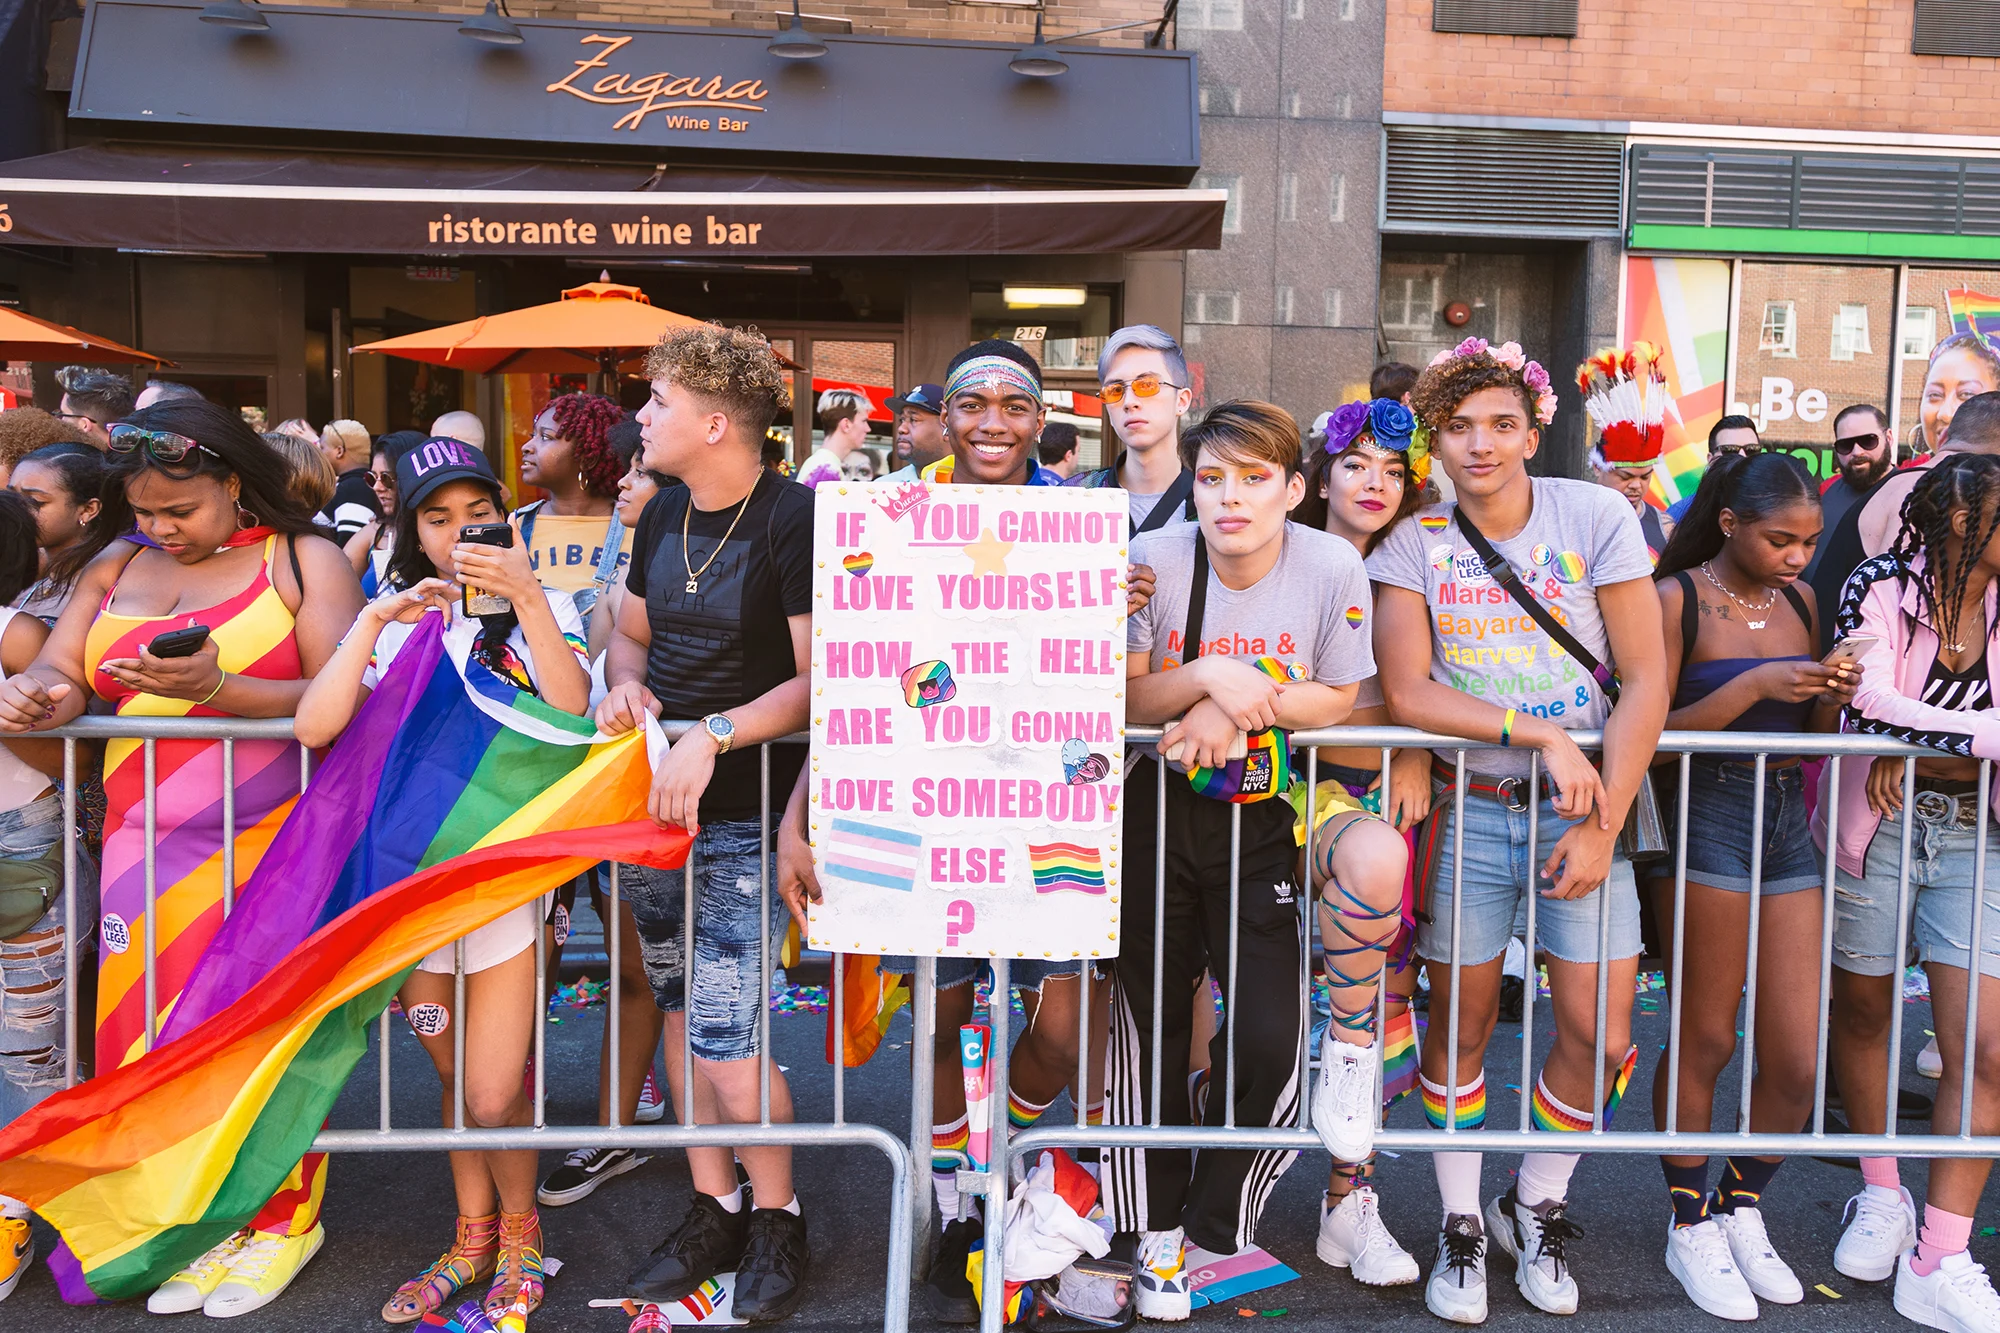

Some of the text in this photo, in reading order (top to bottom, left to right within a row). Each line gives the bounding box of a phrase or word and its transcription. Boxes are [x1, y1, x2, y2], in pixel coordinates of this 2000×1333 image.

[546, 34, 768, 129] Zagara
[666, 115, 748, 131] Wine Bar
[428, 213, 762, 245] ristorante wine bar
[1017, 328, 1043, 339] 216
[1761, 376, 1828, 422] Be
[411, 440, 477, 477] LOVE
[893, 492, 922, 513] Queen
[836, 503, 1123, 547] IF YOU CANNOT
[833, 568, 1118, 612] LOVE YOURSELF
[1543, 577, 1564, 600] &
[1276, 631, 1297, 655] &
[1442, 642, 1538, 668] Harvey
[825, 640, 913, 679] HOW
[951, 641, 1010, 675] THE
[1039, 638, 1116, 676] HELL
[1562, 660, 1580, 684] &
[826, 705, 1115, 745] ARE YOU GONNA
[1243, 774, 1269, 783] PRIDE
[1245, 768, 1270, 777] WORLD
[1241, 780, 1268, 792] NYC
[821, 777, 1121, 823] LOVE SOMEBODY
[931, 847, 1006, 884] ELSE
[103, 920, 124, 934] NICE
[946, 899, 976, 947] ?
[415, 1008, 427, 1032] NICE
